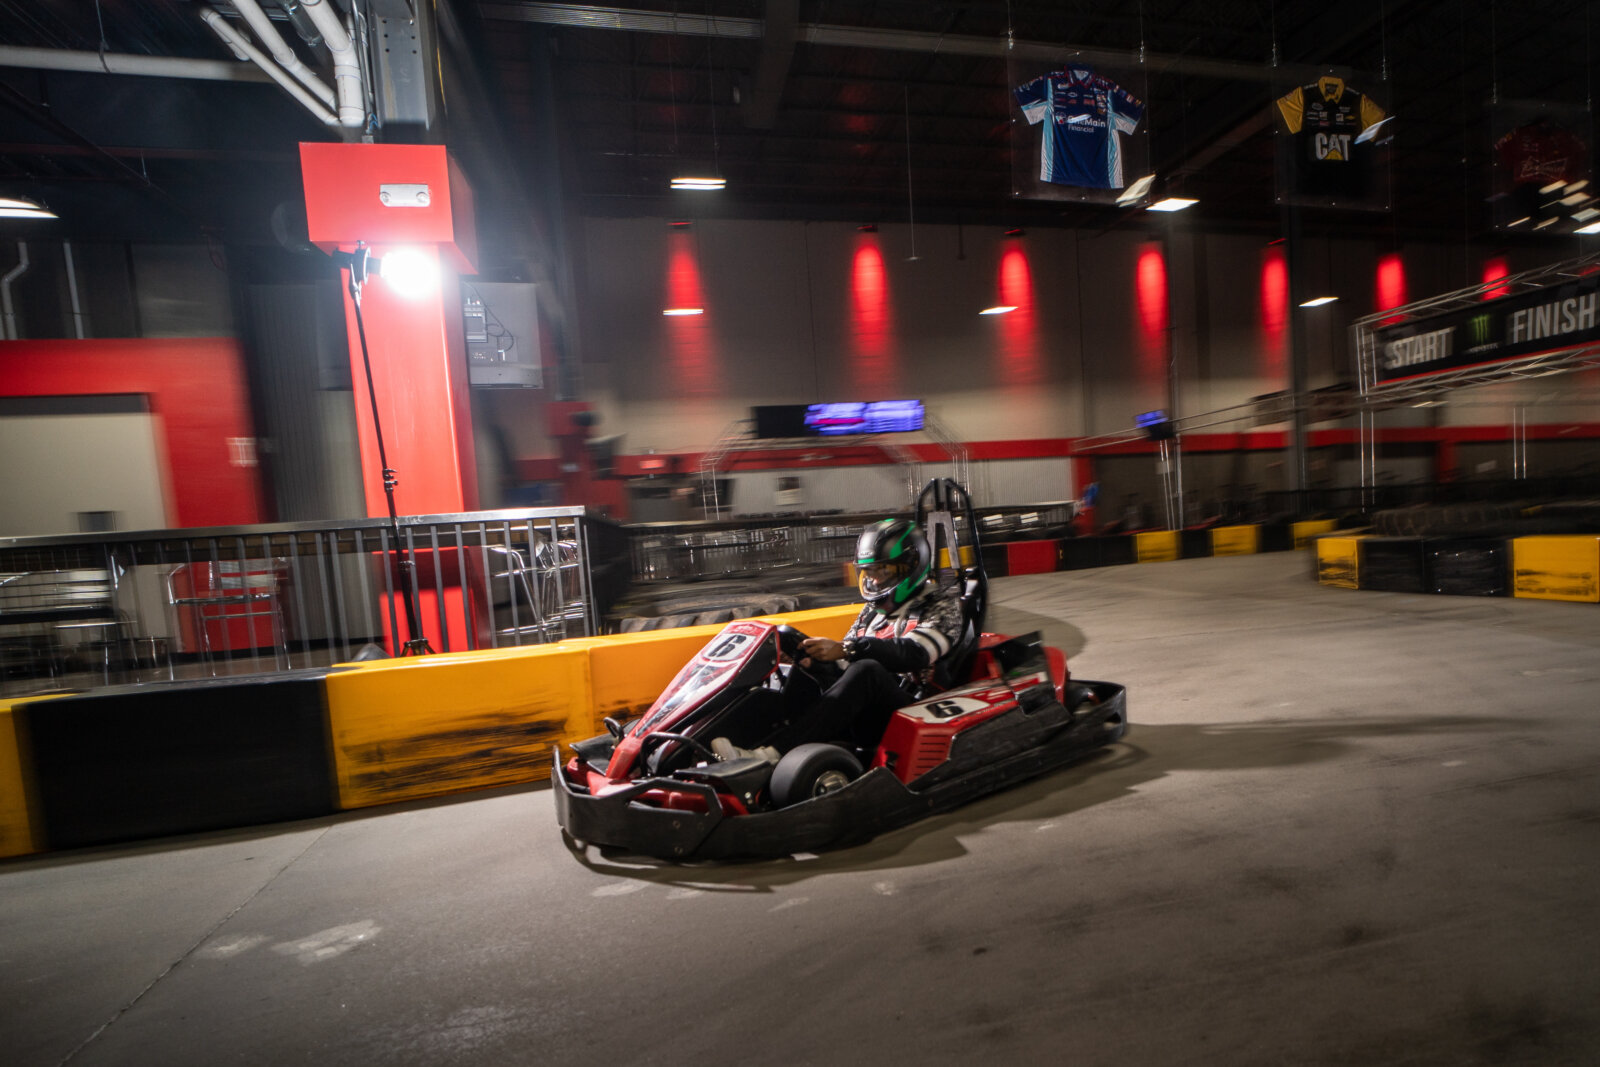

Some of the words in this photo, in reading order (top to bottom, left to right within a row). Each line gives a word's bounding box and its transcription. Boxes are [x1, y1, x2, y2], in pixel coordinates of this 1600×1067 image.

[1068, 124, 1095, 133] Financial
[1315, 132, 1352, 162] CAT
[1512, 293, 1597, 344] FINISH
[1388, 327, 1453, 369] START
[707, 634, 747, 658] 6
[926, 700, 965, 719] 6
